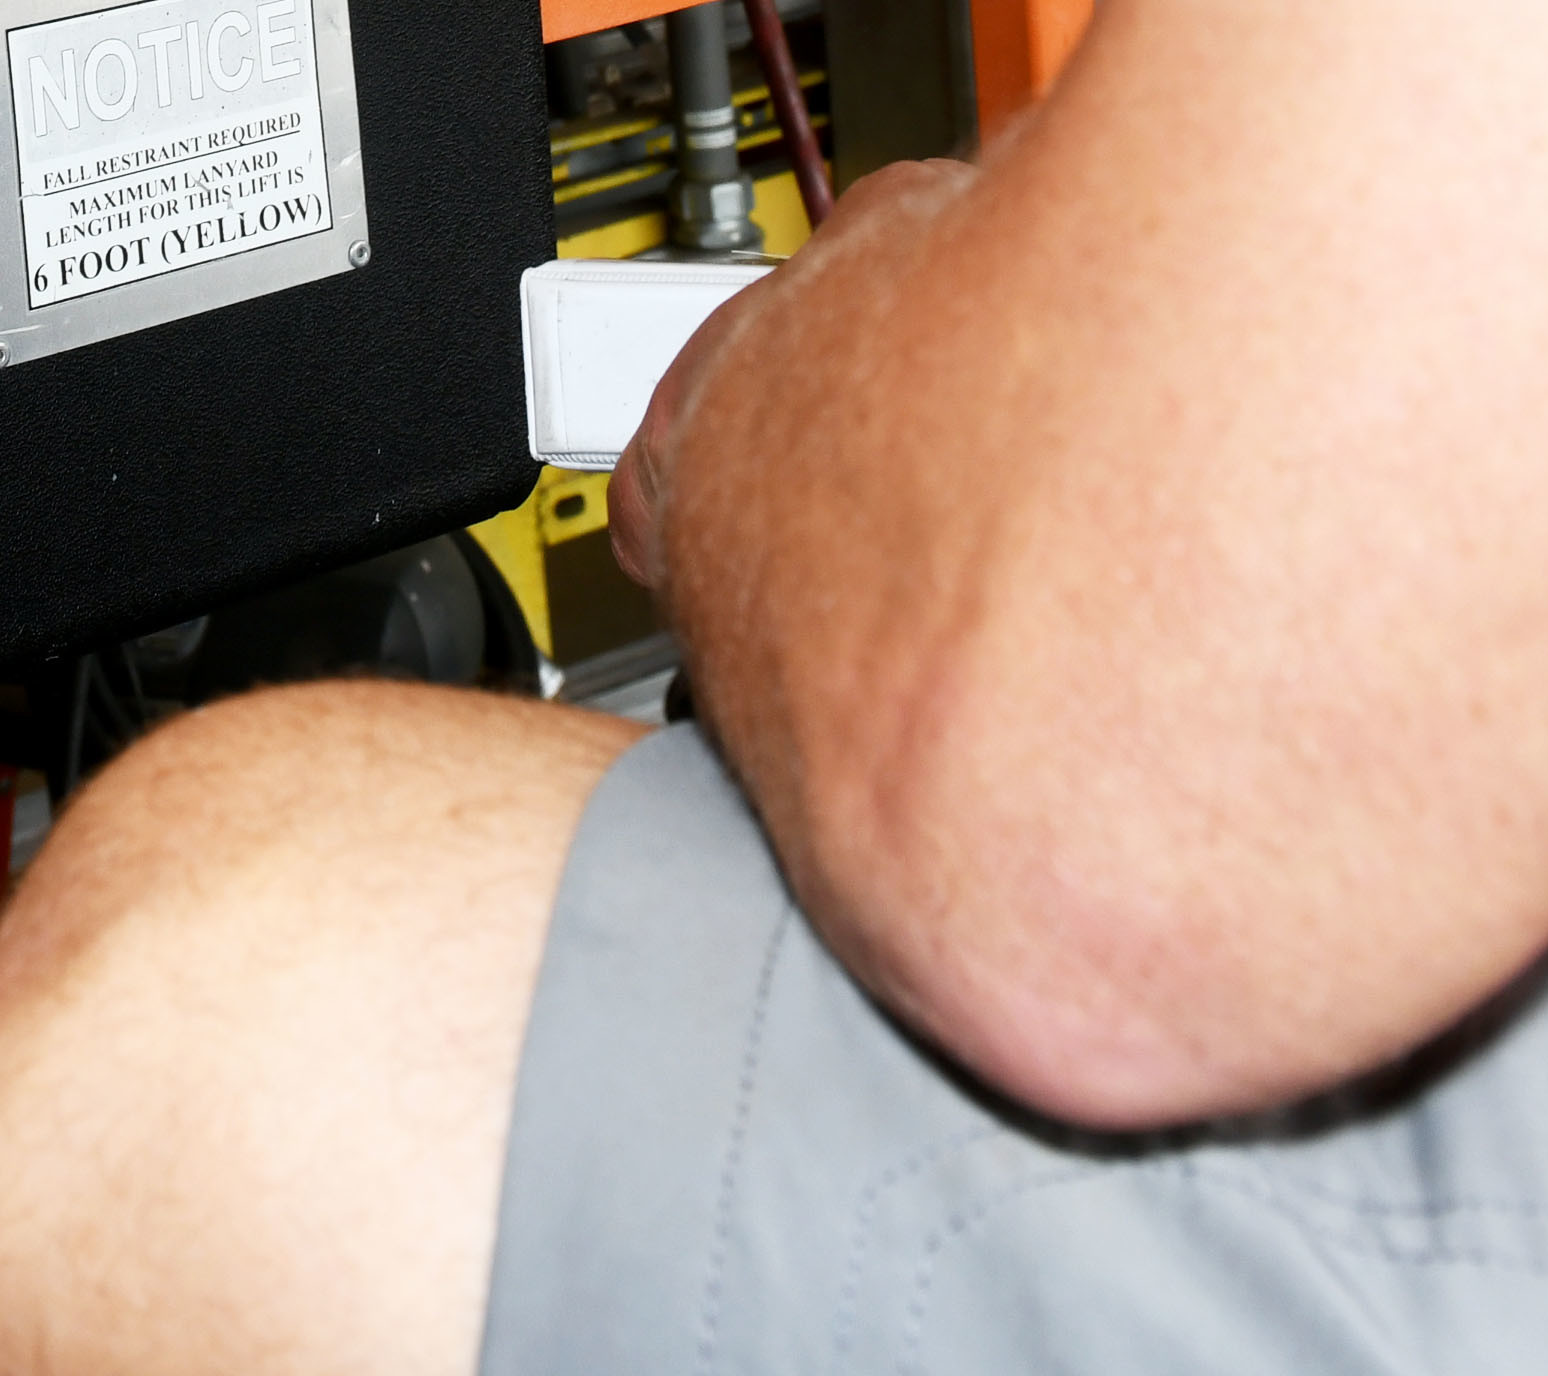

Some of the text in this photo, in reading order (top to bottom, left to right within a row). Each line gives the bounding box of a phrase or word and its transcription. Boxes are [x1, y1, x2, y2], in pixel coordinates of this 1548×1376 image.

[44, 112, 301, 190] FALL RESTRAINT REQUIRED
[70, 151, 278, 218] MAXIMUM LANYARD
[33, 194, 322, 292] 6 FOOT (YELLOW)
[46, 166, 304, 248] LENGTH FOR THIS LIFT IS
